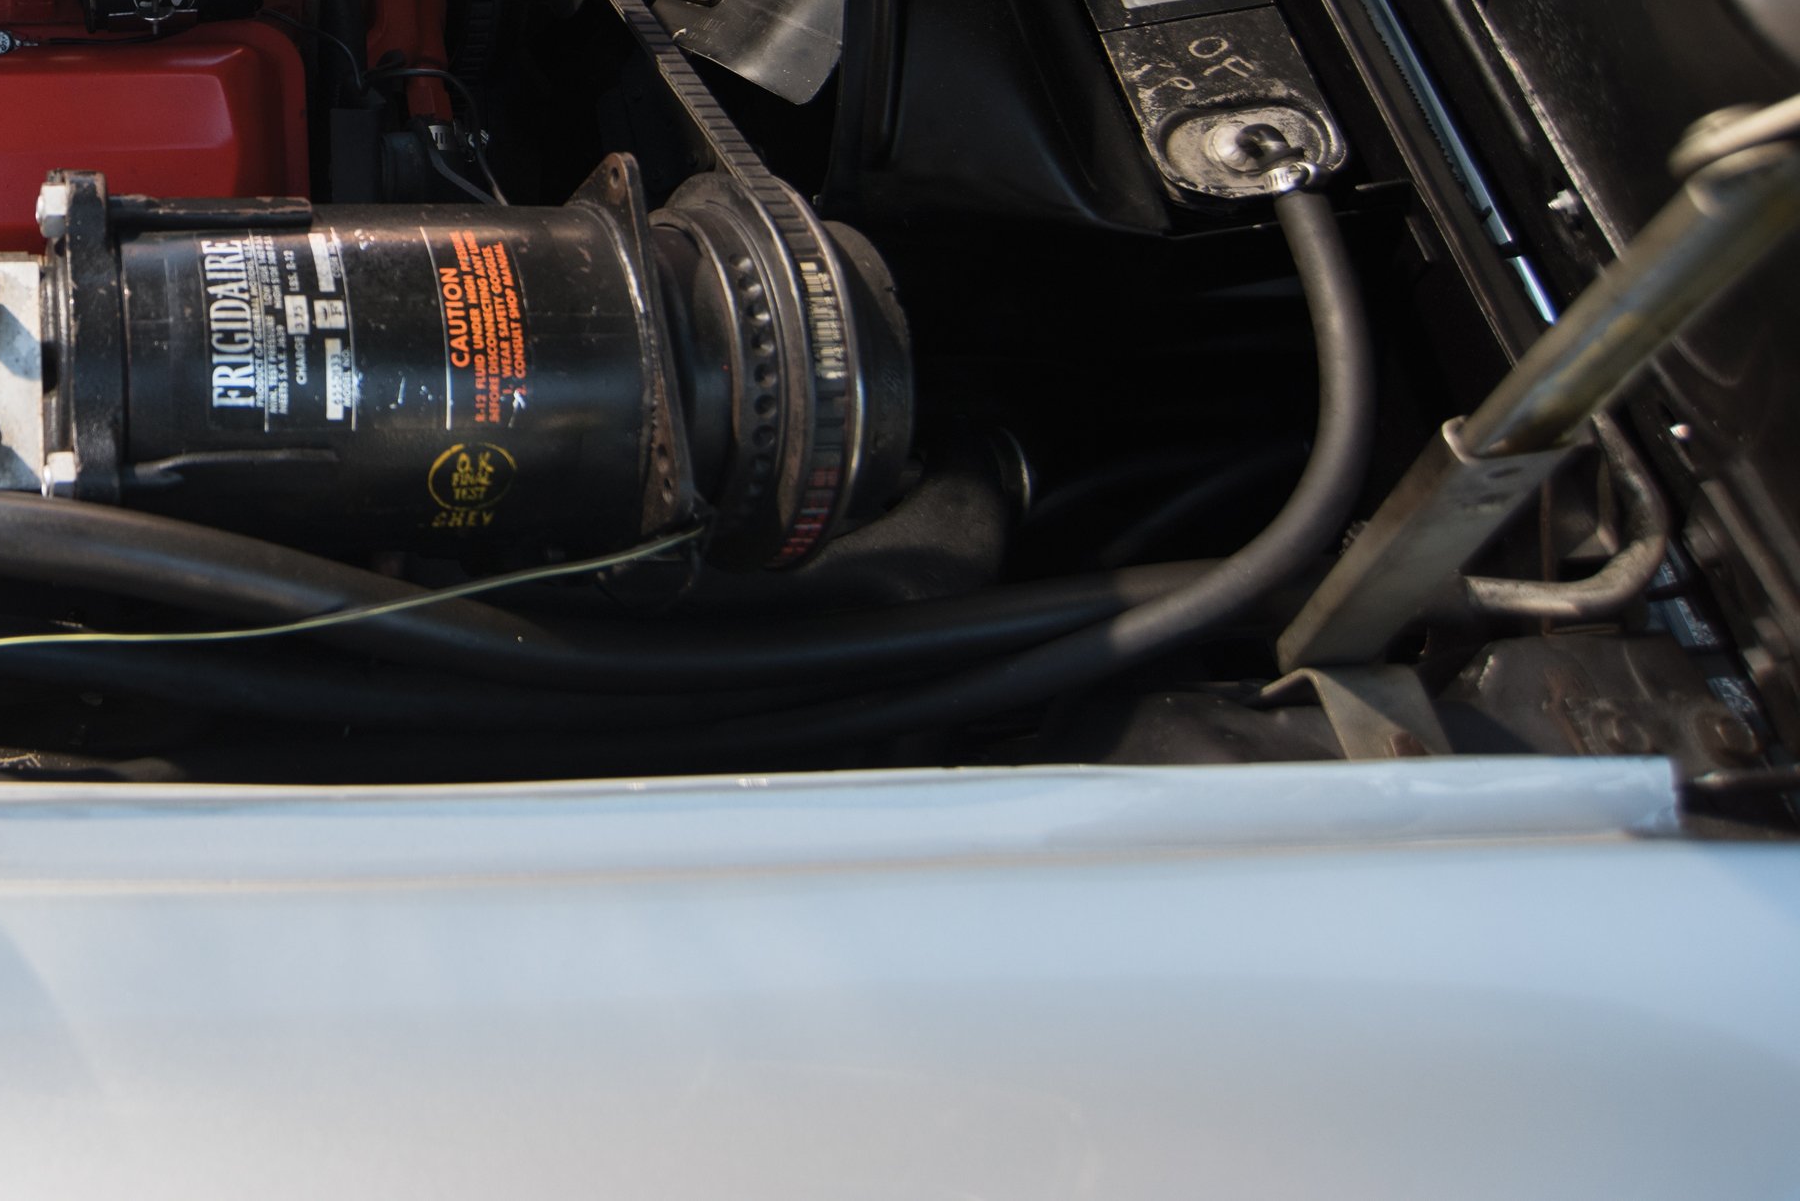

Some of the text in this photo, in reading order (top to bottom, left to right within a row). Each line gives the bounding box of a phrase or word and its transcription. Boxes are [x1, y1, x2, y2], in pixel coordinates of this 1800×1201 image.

[258, 265, 270, 283] SIDE
[268, 265, 280, 283] SIDE
[282, 249, 297, 270] R-12
[471, 254, 485, 277] ANY
[261, 285, 273, 305] LOW
[272, 284, 283, 309] HIGH
[463, 275, 478, 303] HIGH
[505, 288, 520, 319] SHOP
[201, 239, 256, 409] FRIGIDAIRE
[250, 298, 262, 340] GENERAL
[439, 268, 471, 367] CAUTION
[469, 308, 484, 349] UNDER
[476, 277, 499, 374] DISCONNECTING
[493, 296, 509, 337] SAFETY
[253, 341, 263, 357] OF
[293, 335, 307, 385] CHARGE
[499, 341, 513, 378] WEAR
[510, 322, 526, 379] CONSULT
[254, 357, 266, 407] PRODUCT
[267, 363, 278, 386] TEST
[341, 370, 353, 407] MODEL
[474, 354, 486, 389] FLUID
[277, 380, 289, 414] MEETS
[475, 394, 486, 422] R-12
[488, 376, 500, 423] BEFORE
[453, 486, 487, 501] TEST
[431, 509, 494, 527] CHEV
